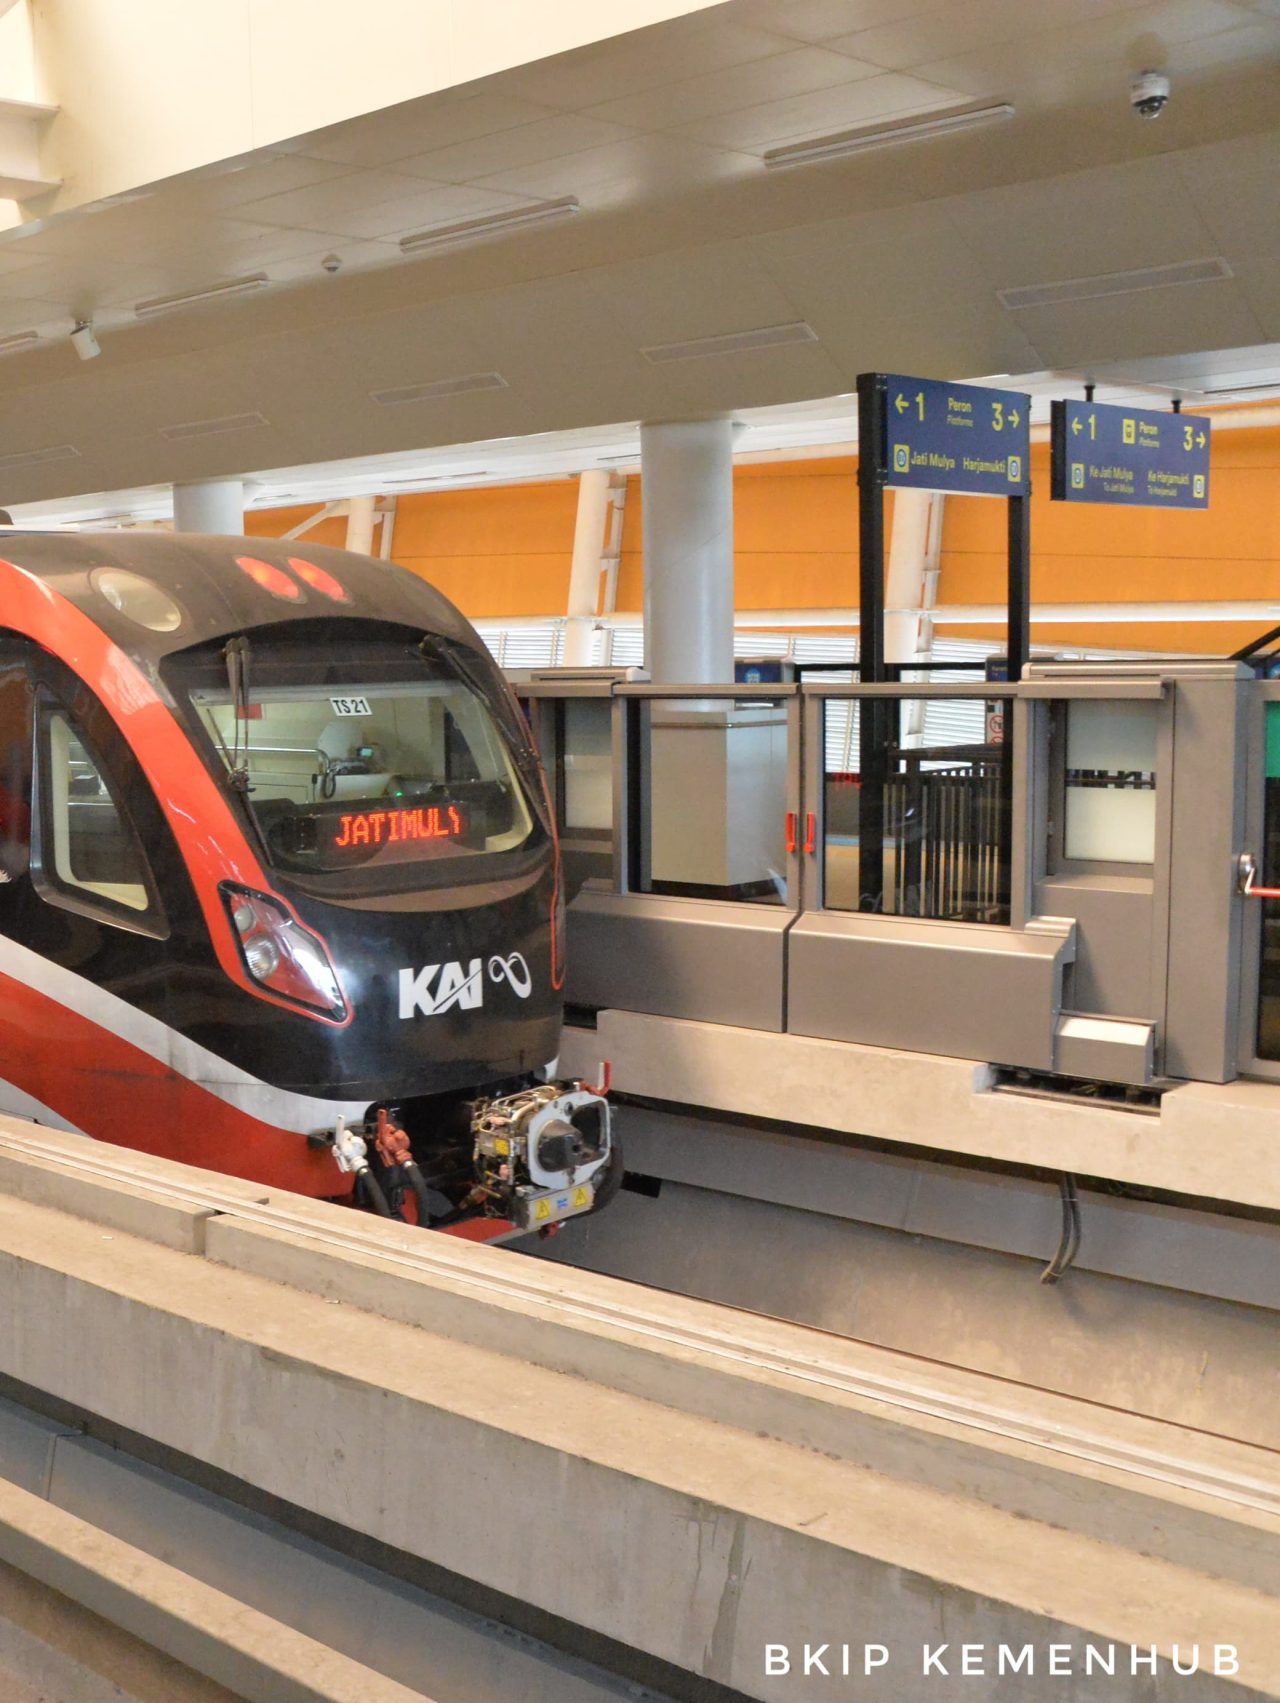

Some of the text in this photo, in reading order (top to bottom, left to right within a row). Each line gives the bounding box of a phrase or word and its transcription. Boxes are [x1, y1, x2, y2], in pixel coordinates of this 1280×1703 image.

[915, 392, 925, 421] 1
[947, 397, 972, 412] Peron
[991, 402, 1004, 432] 3
[1088, 414, 1096, 441] 1
[1183, 425, 1193, 451] 3
[911, 450, 956, 471] Jati Mulya
[963, 457, 1006, 474] Harjamukti
[333, 700, 368, 714] TS 21
[399, 958, 483, 1019] KAI
